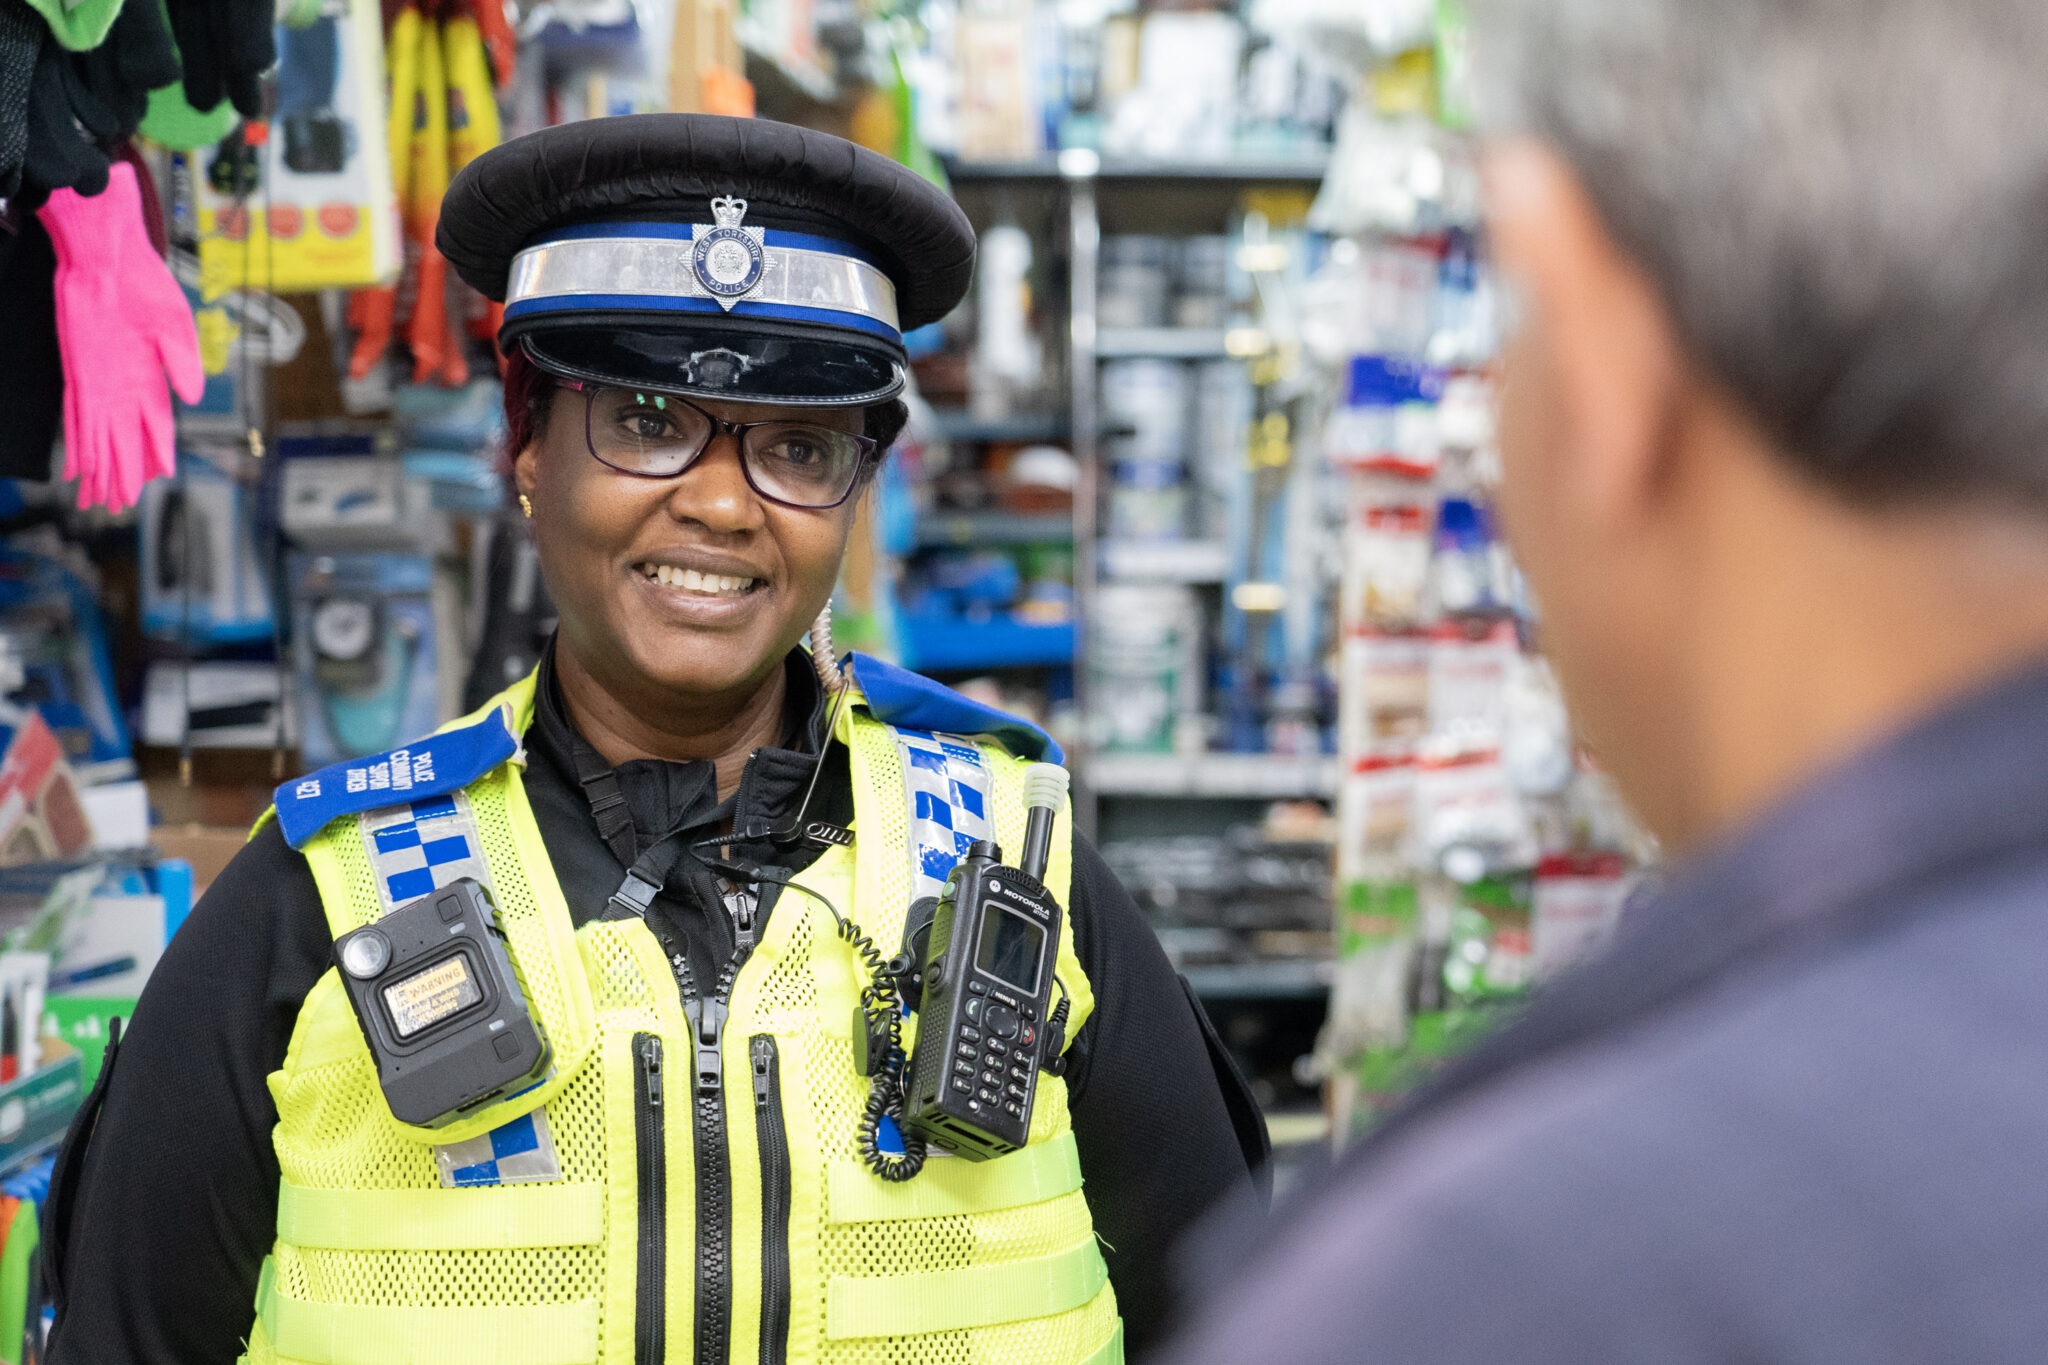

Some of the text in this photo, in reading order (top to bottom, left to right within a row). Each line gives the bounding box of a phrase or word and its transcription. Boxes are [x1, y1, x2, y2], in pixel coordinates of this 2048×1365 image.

[697, 229, 760, 263] WEST YORKSHIRE
[708, 279, 749, 292] POLICE
[390, 750, 412, 790] COMMUNITY
[412, 752, 435, 782] POLICE
[1003, 888, 1050, 916] MOTOROLA
[409, 967, 461, 998] WARNING
